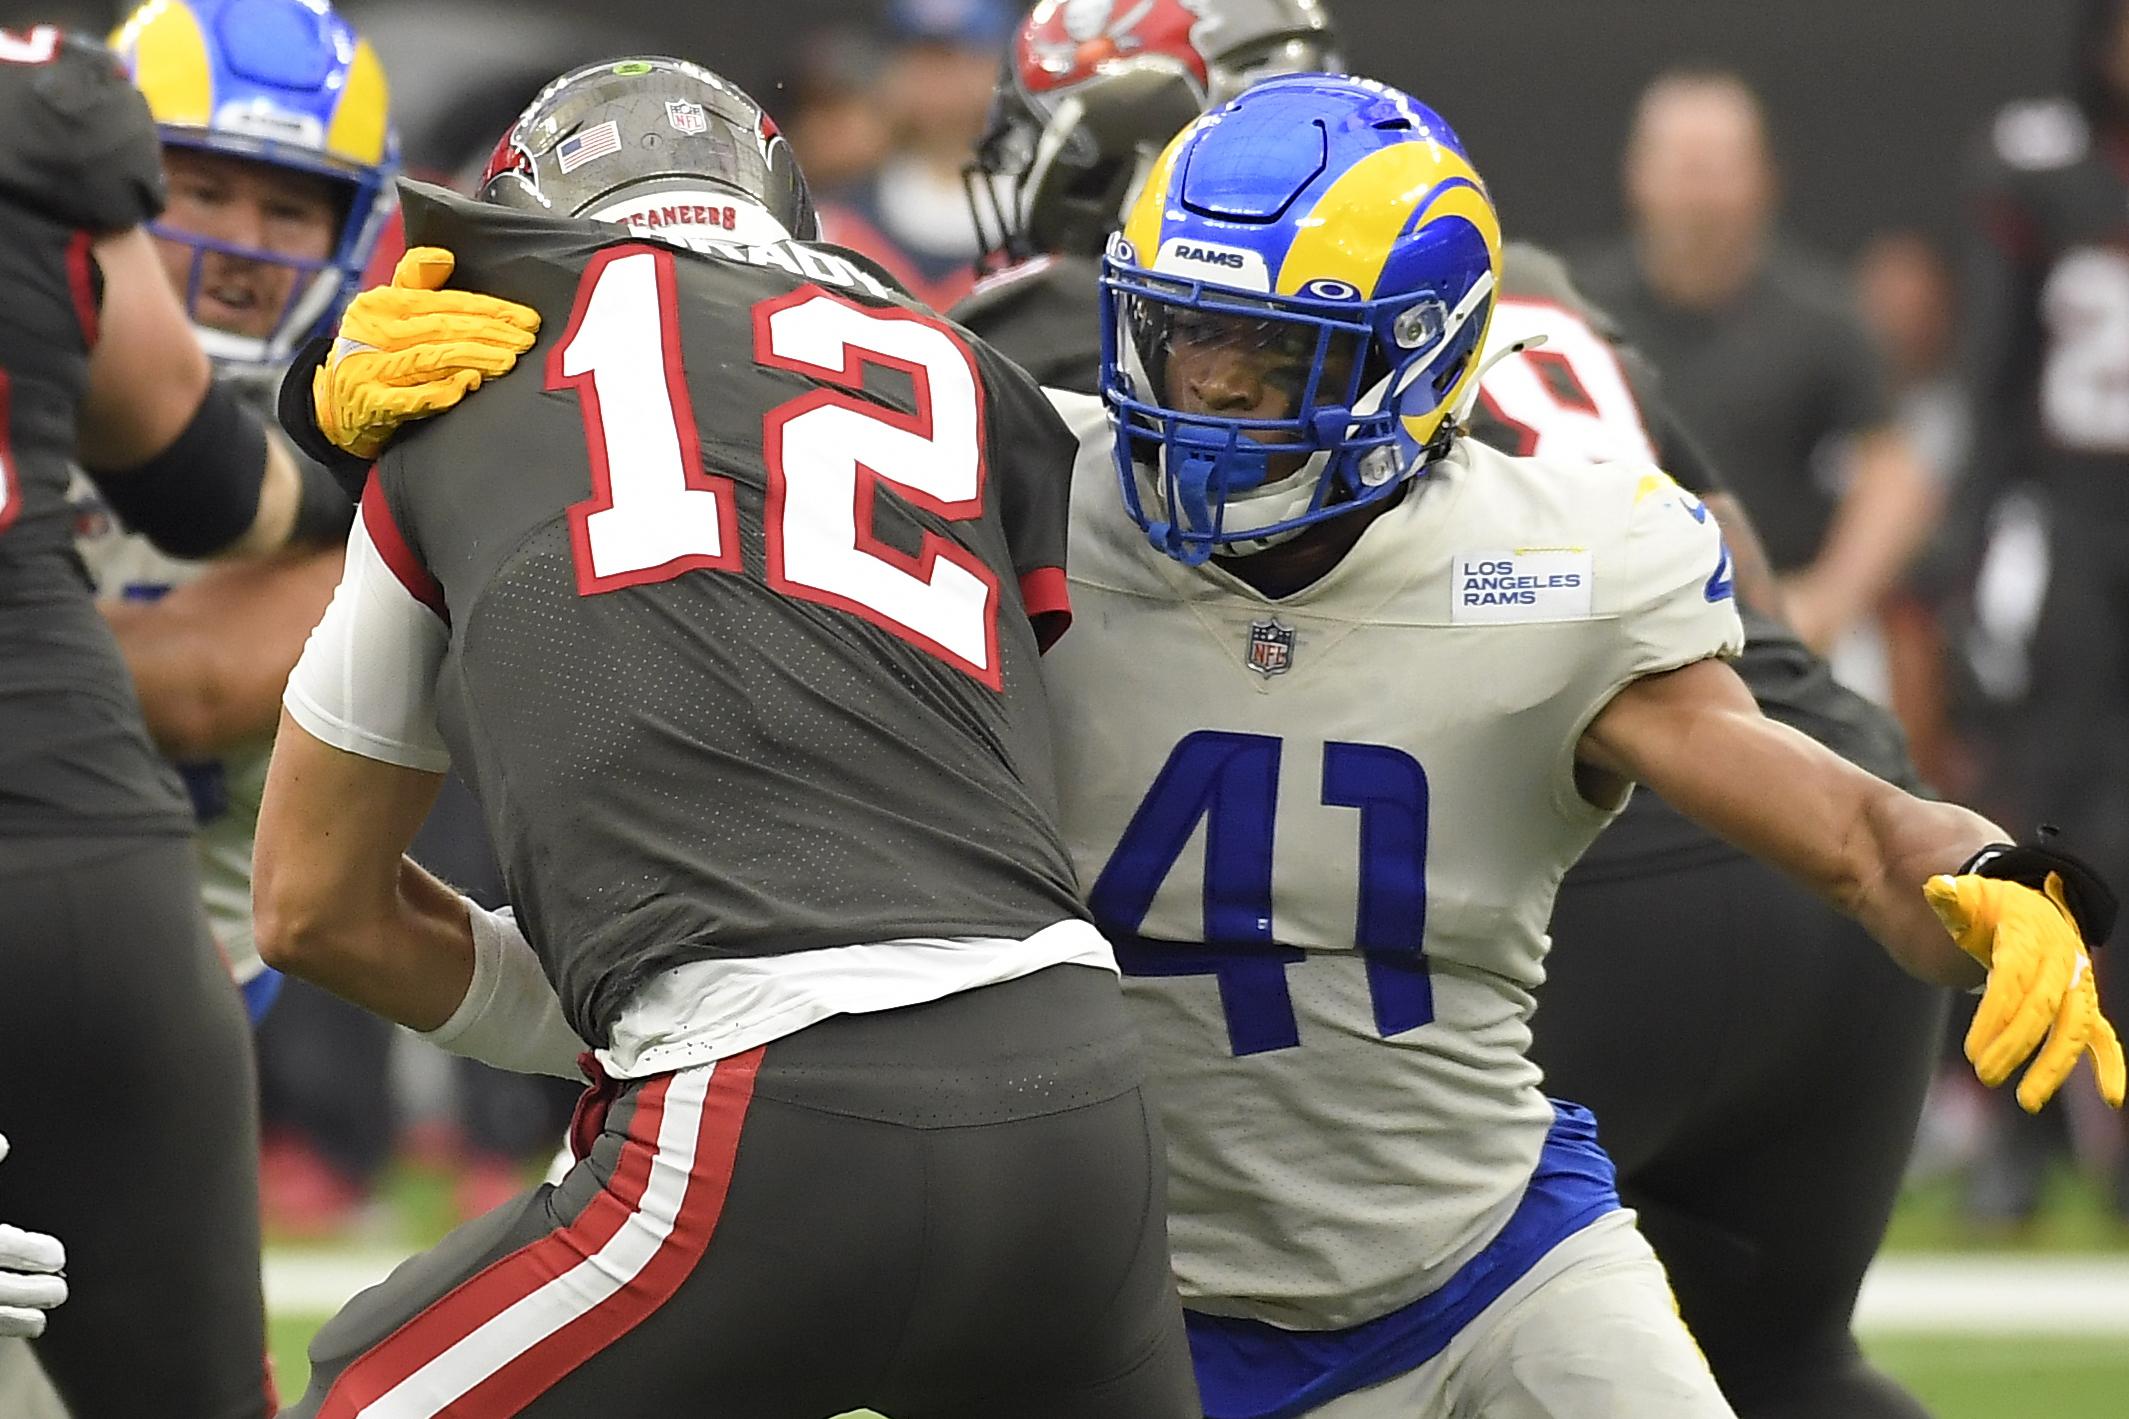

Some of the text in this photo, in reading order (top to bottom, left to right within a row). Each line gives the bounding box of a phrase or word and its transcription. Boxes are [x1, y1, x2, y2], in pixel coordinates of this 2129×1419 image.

[616, 205, 736, 231] CANEERS
[1174, 244, 1244, 269] RAMS
[545, 244, 1003, 692] 12
[1464, 562, 1513, 576] LOS
[1463, 574, 1581, 591] ANGELES
[1463, 591, 1536, 606] RAMS
[1254, 643, 1287, 668] NFL
[1089, 728, 1435, 1057] 41
